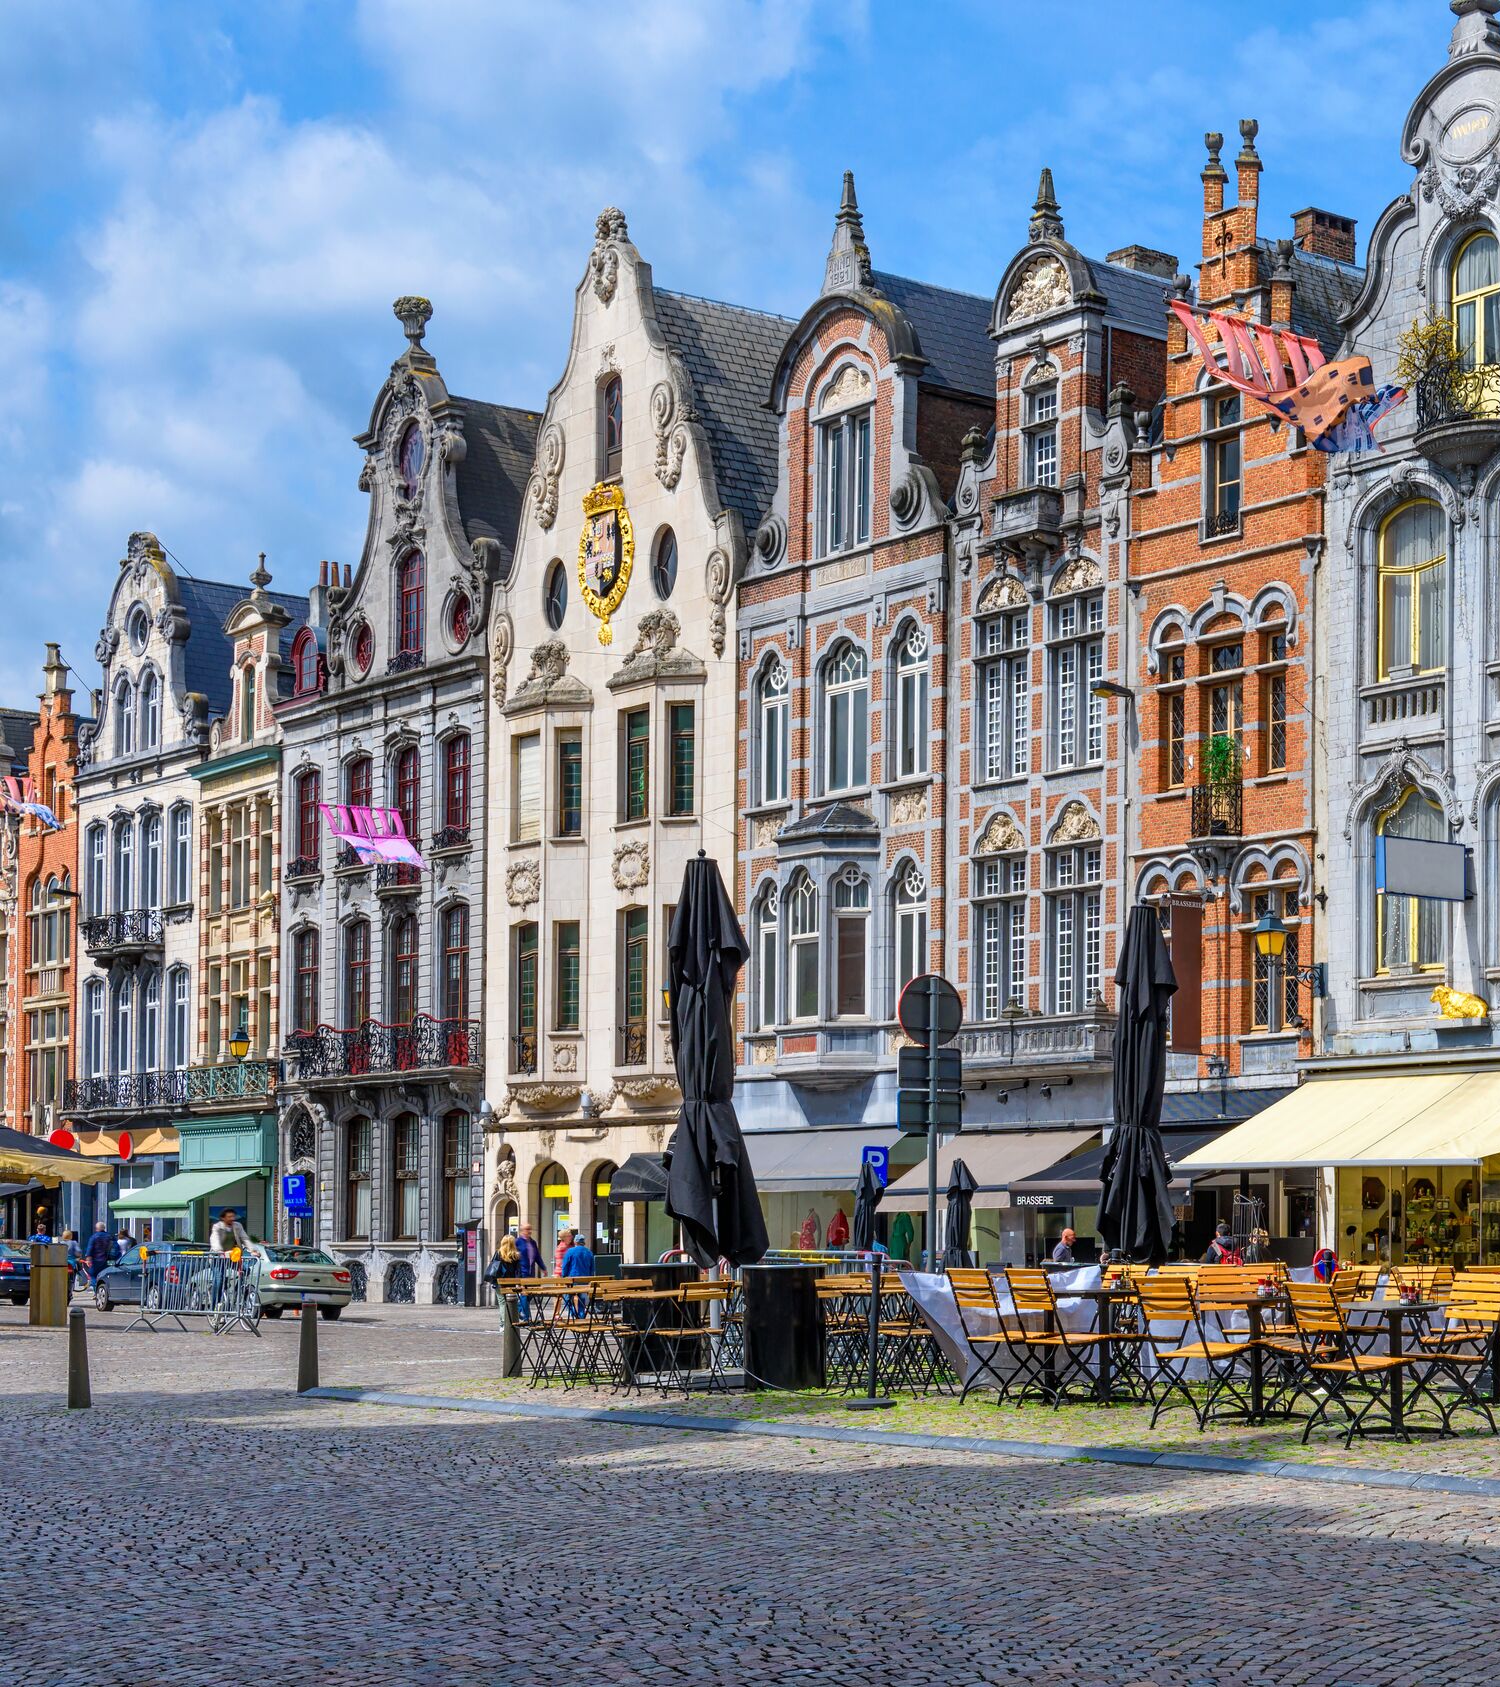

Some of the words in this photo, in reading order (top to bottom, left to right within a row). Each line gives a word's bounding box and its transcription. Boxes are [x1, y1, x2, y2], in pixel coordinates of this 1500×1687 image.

[829, 256, 851, 273] ANNO
[1171, 899, 1202, 909] BRASSERIE
[866, 1150, 885, 1168] P
[287, 1178, 300, 1195] P
[1016, 1195, 1054, 1206] BRASSERIE
